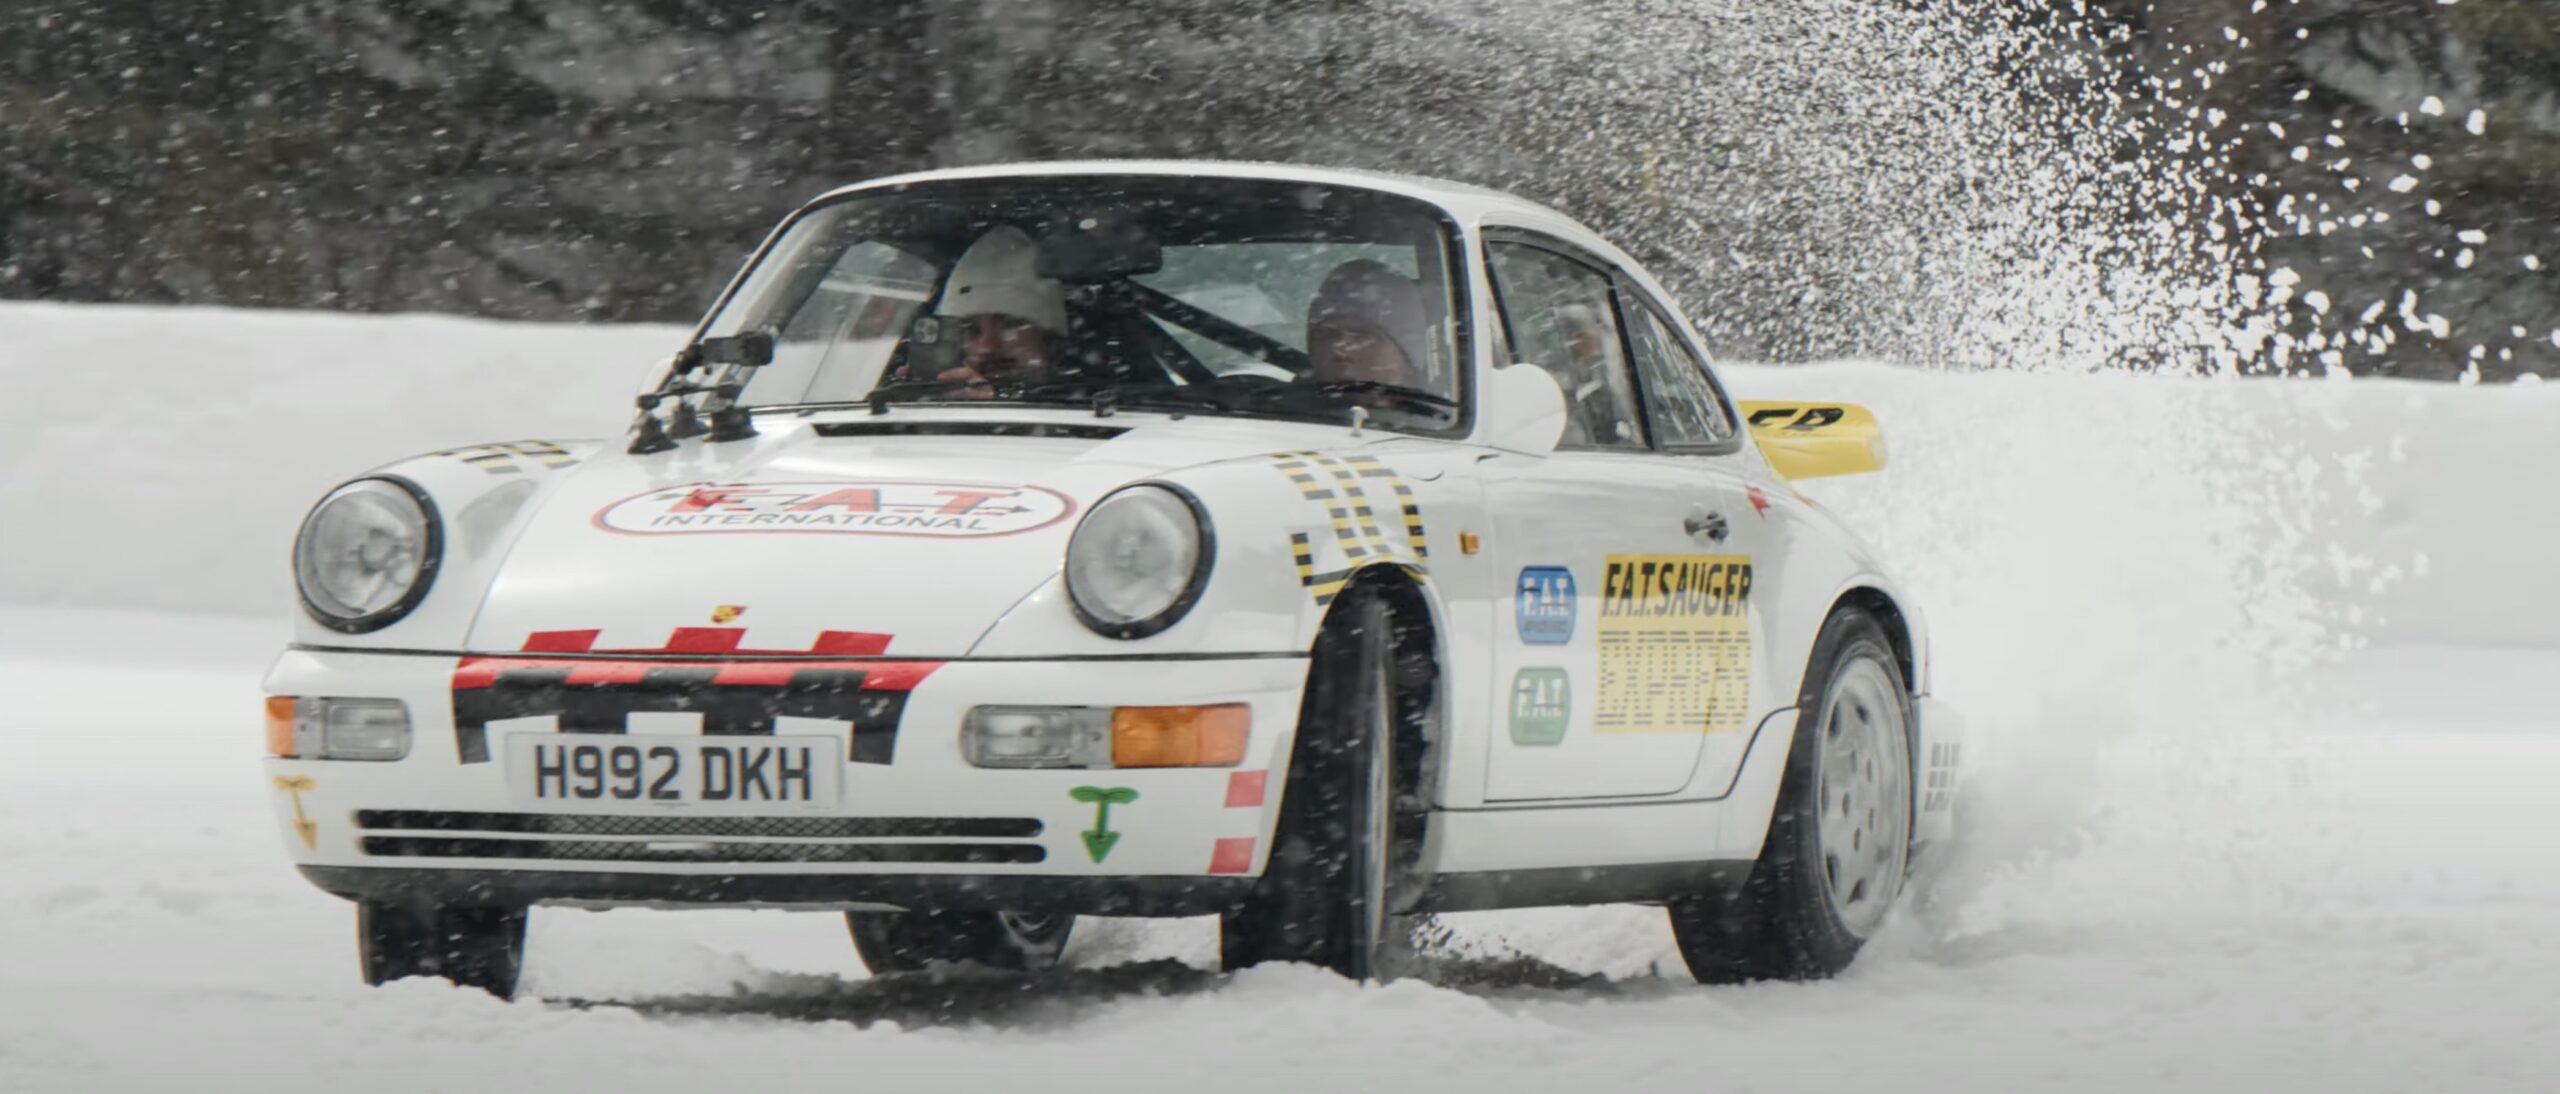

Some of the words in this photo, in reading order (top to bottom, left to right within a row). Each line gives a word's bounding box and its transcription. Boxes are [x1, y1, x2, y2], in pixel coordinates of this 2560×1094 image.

[651, 513, 988, 531] INTERNATIONAL
[534, 744, 681, 800] H992
[699, 745, 812, 801] DKH
